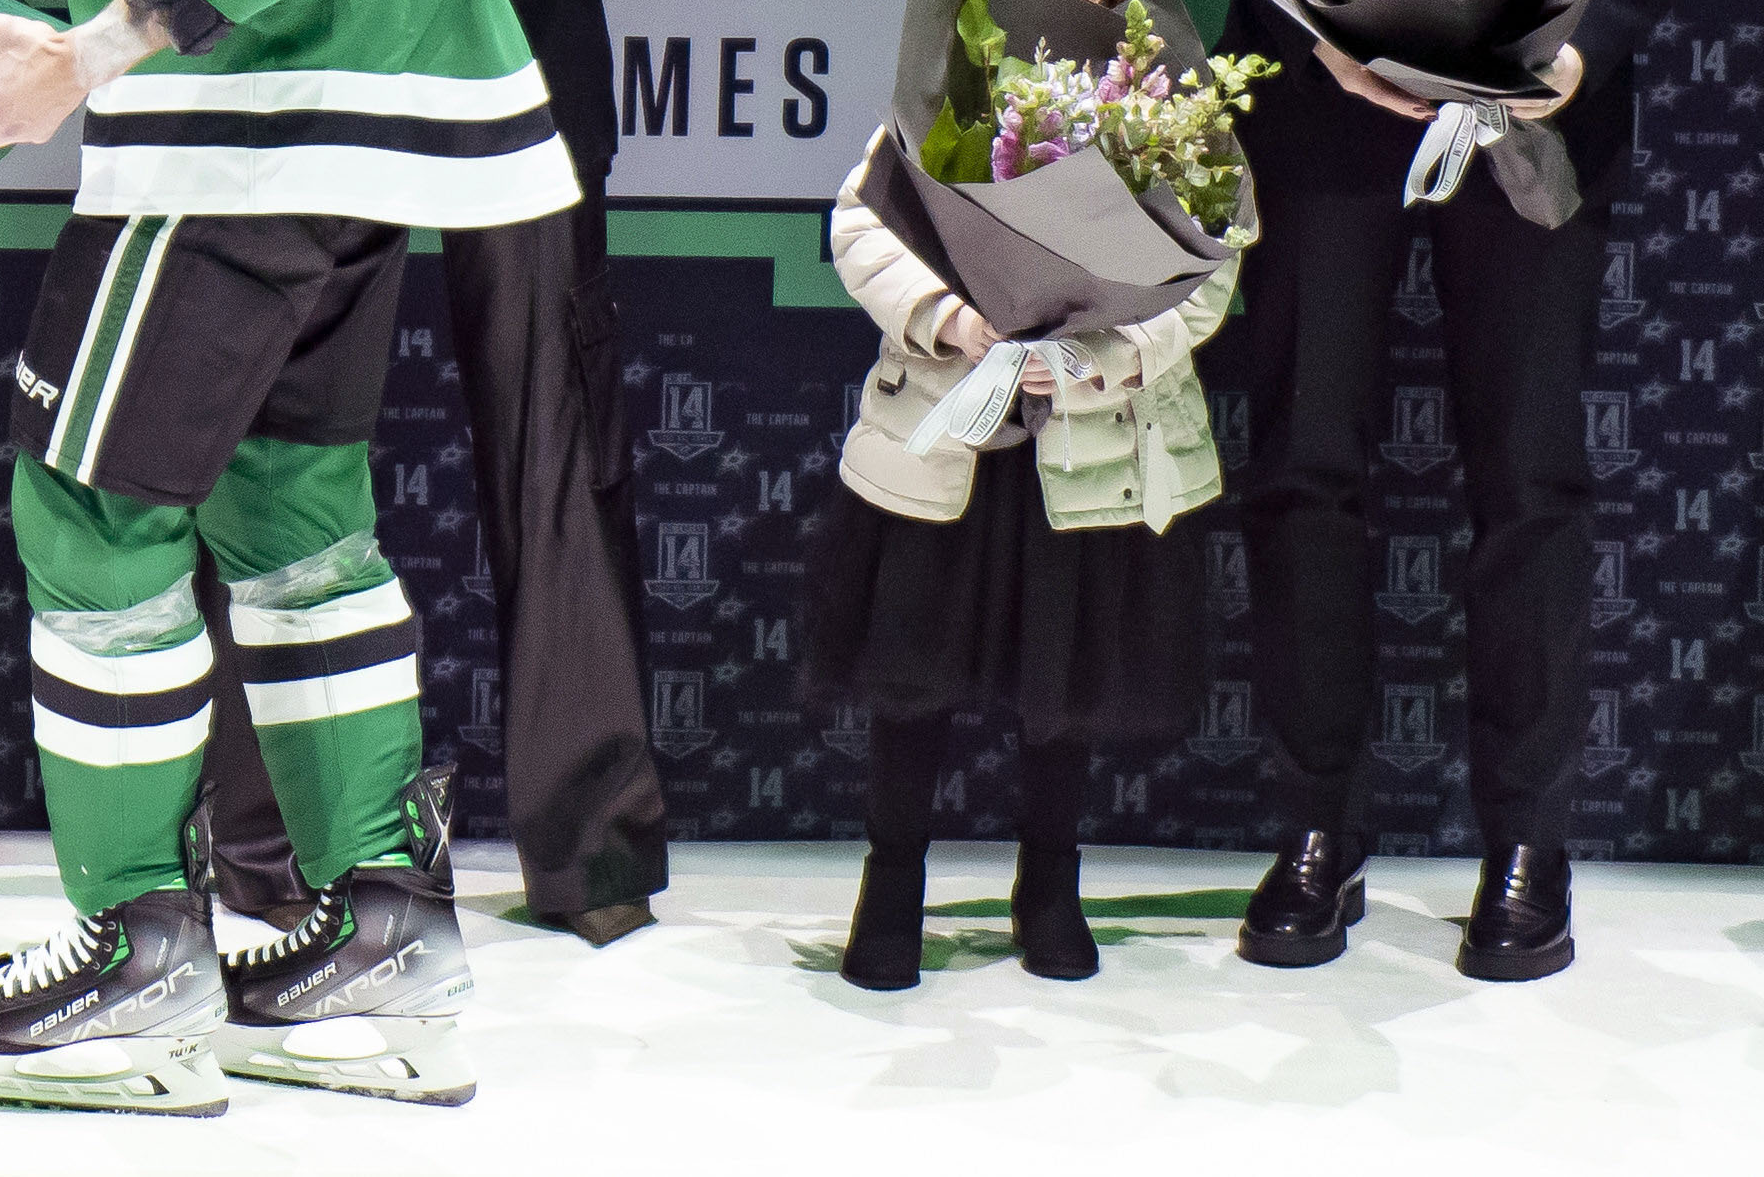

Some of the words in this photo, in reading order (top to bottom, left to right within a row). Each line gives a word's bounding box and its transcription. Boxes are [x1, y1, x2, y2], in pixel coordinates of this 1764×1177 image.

[1691, 40, 1726, 82] 14
[622, 36, 830, 138] MES
[1686, 190, 1721, 232] 14
[1680, 340, 1715, 382] 14
[1401, 400, 1435, 441] 14
[394, 464, 429, 506] 14
[758, 471, 793, 513] 14
[1675, 489, 1710, 531] 14
[665, 536, 699, 577] 14
[1396, 549, 1430, 590] 14
[753, 619, 788, 661] 14
[1670, 639, 1705, 681] 14
[749, 767, 784, 809] 14
[1113, 773, 1148, 815] 14
[1666, 789, 1701, 831] 14
[277, 961, 338, 1008] BAUER
[28, 988, 100, 1039] BAUER
